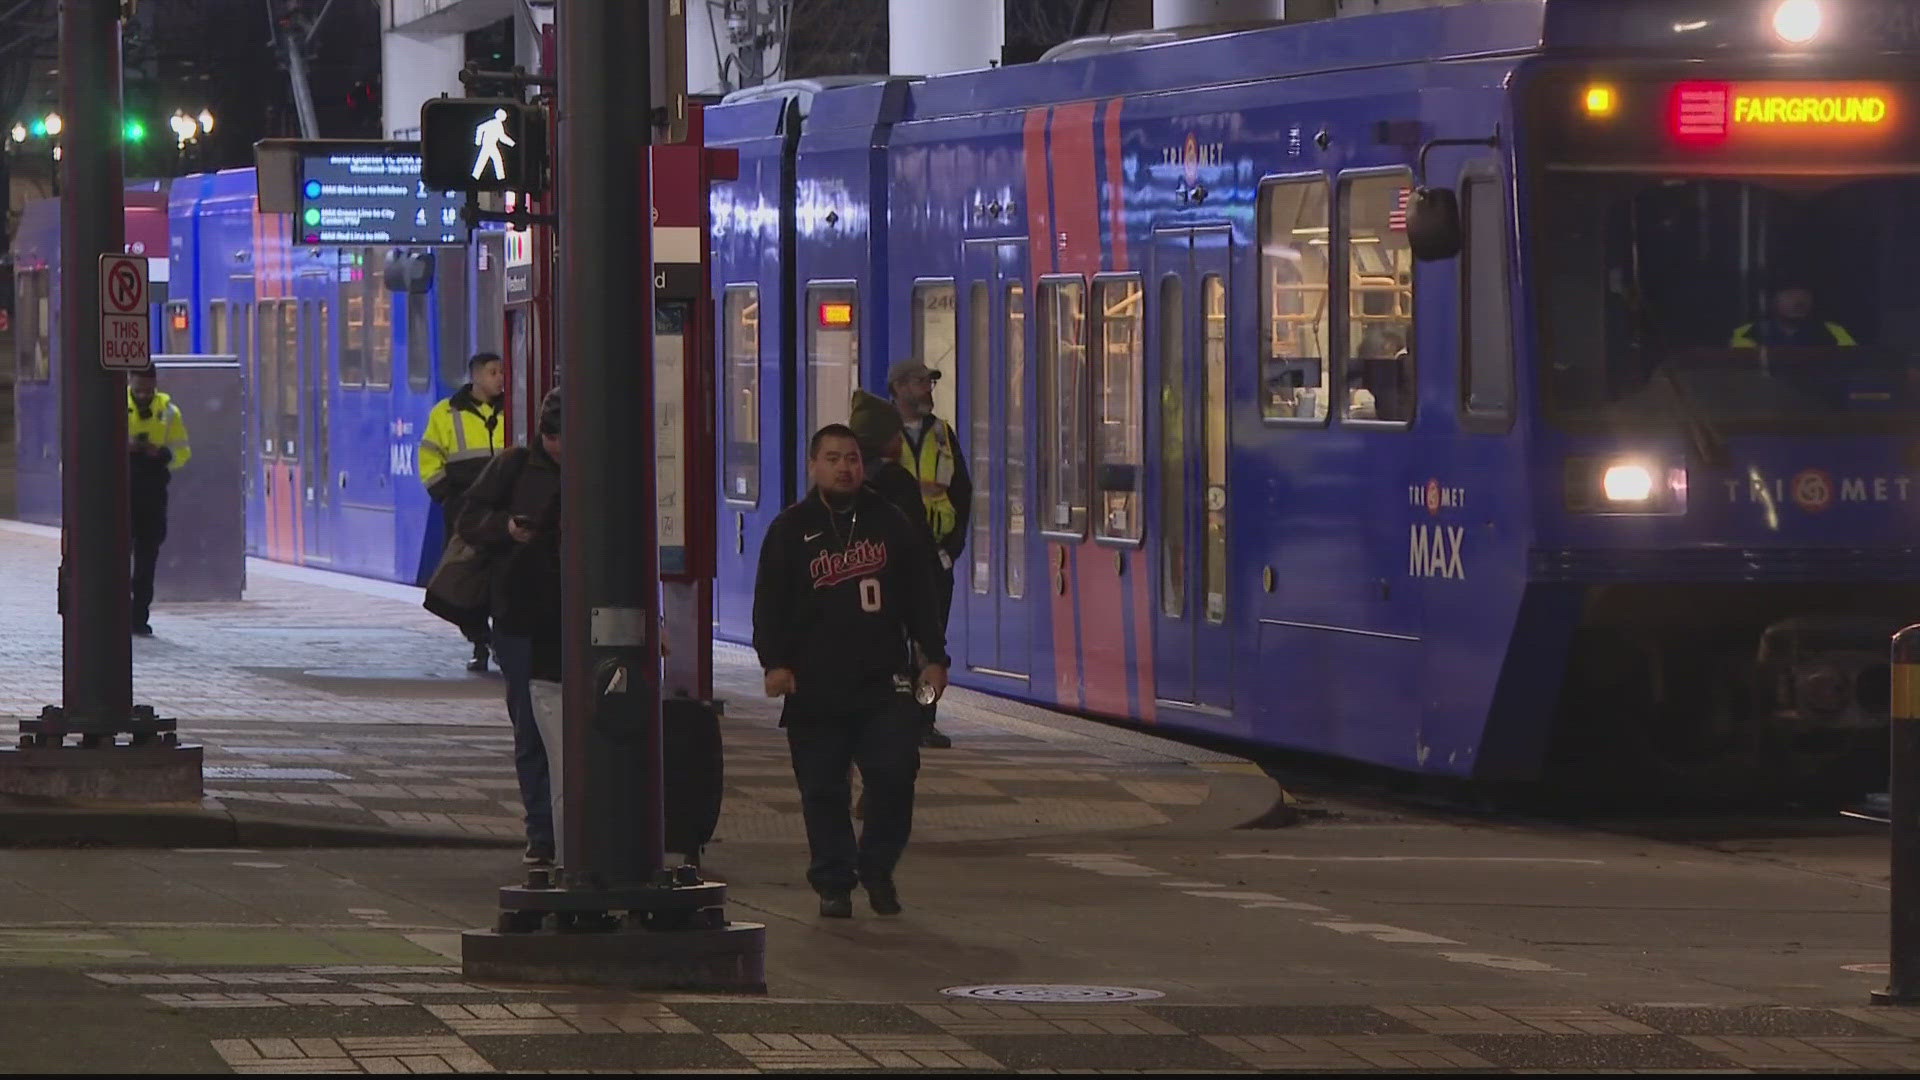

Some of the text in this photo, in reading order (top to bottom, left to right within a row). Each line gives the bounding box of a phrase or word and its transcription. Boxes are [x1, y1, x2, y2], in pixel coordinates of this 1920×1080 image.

[1734, 97, 1885, 124] FAIRGROUND
[111, 321, 140, 339] THIS
[105, 340, 146, 359] BLOCK
[390, 442, 413, 475] MAX
[1408, 484, 1465, 507] TRI MET
[1409, 523, 1465, 580] MAX
[859, 578, 881, 612] 0
